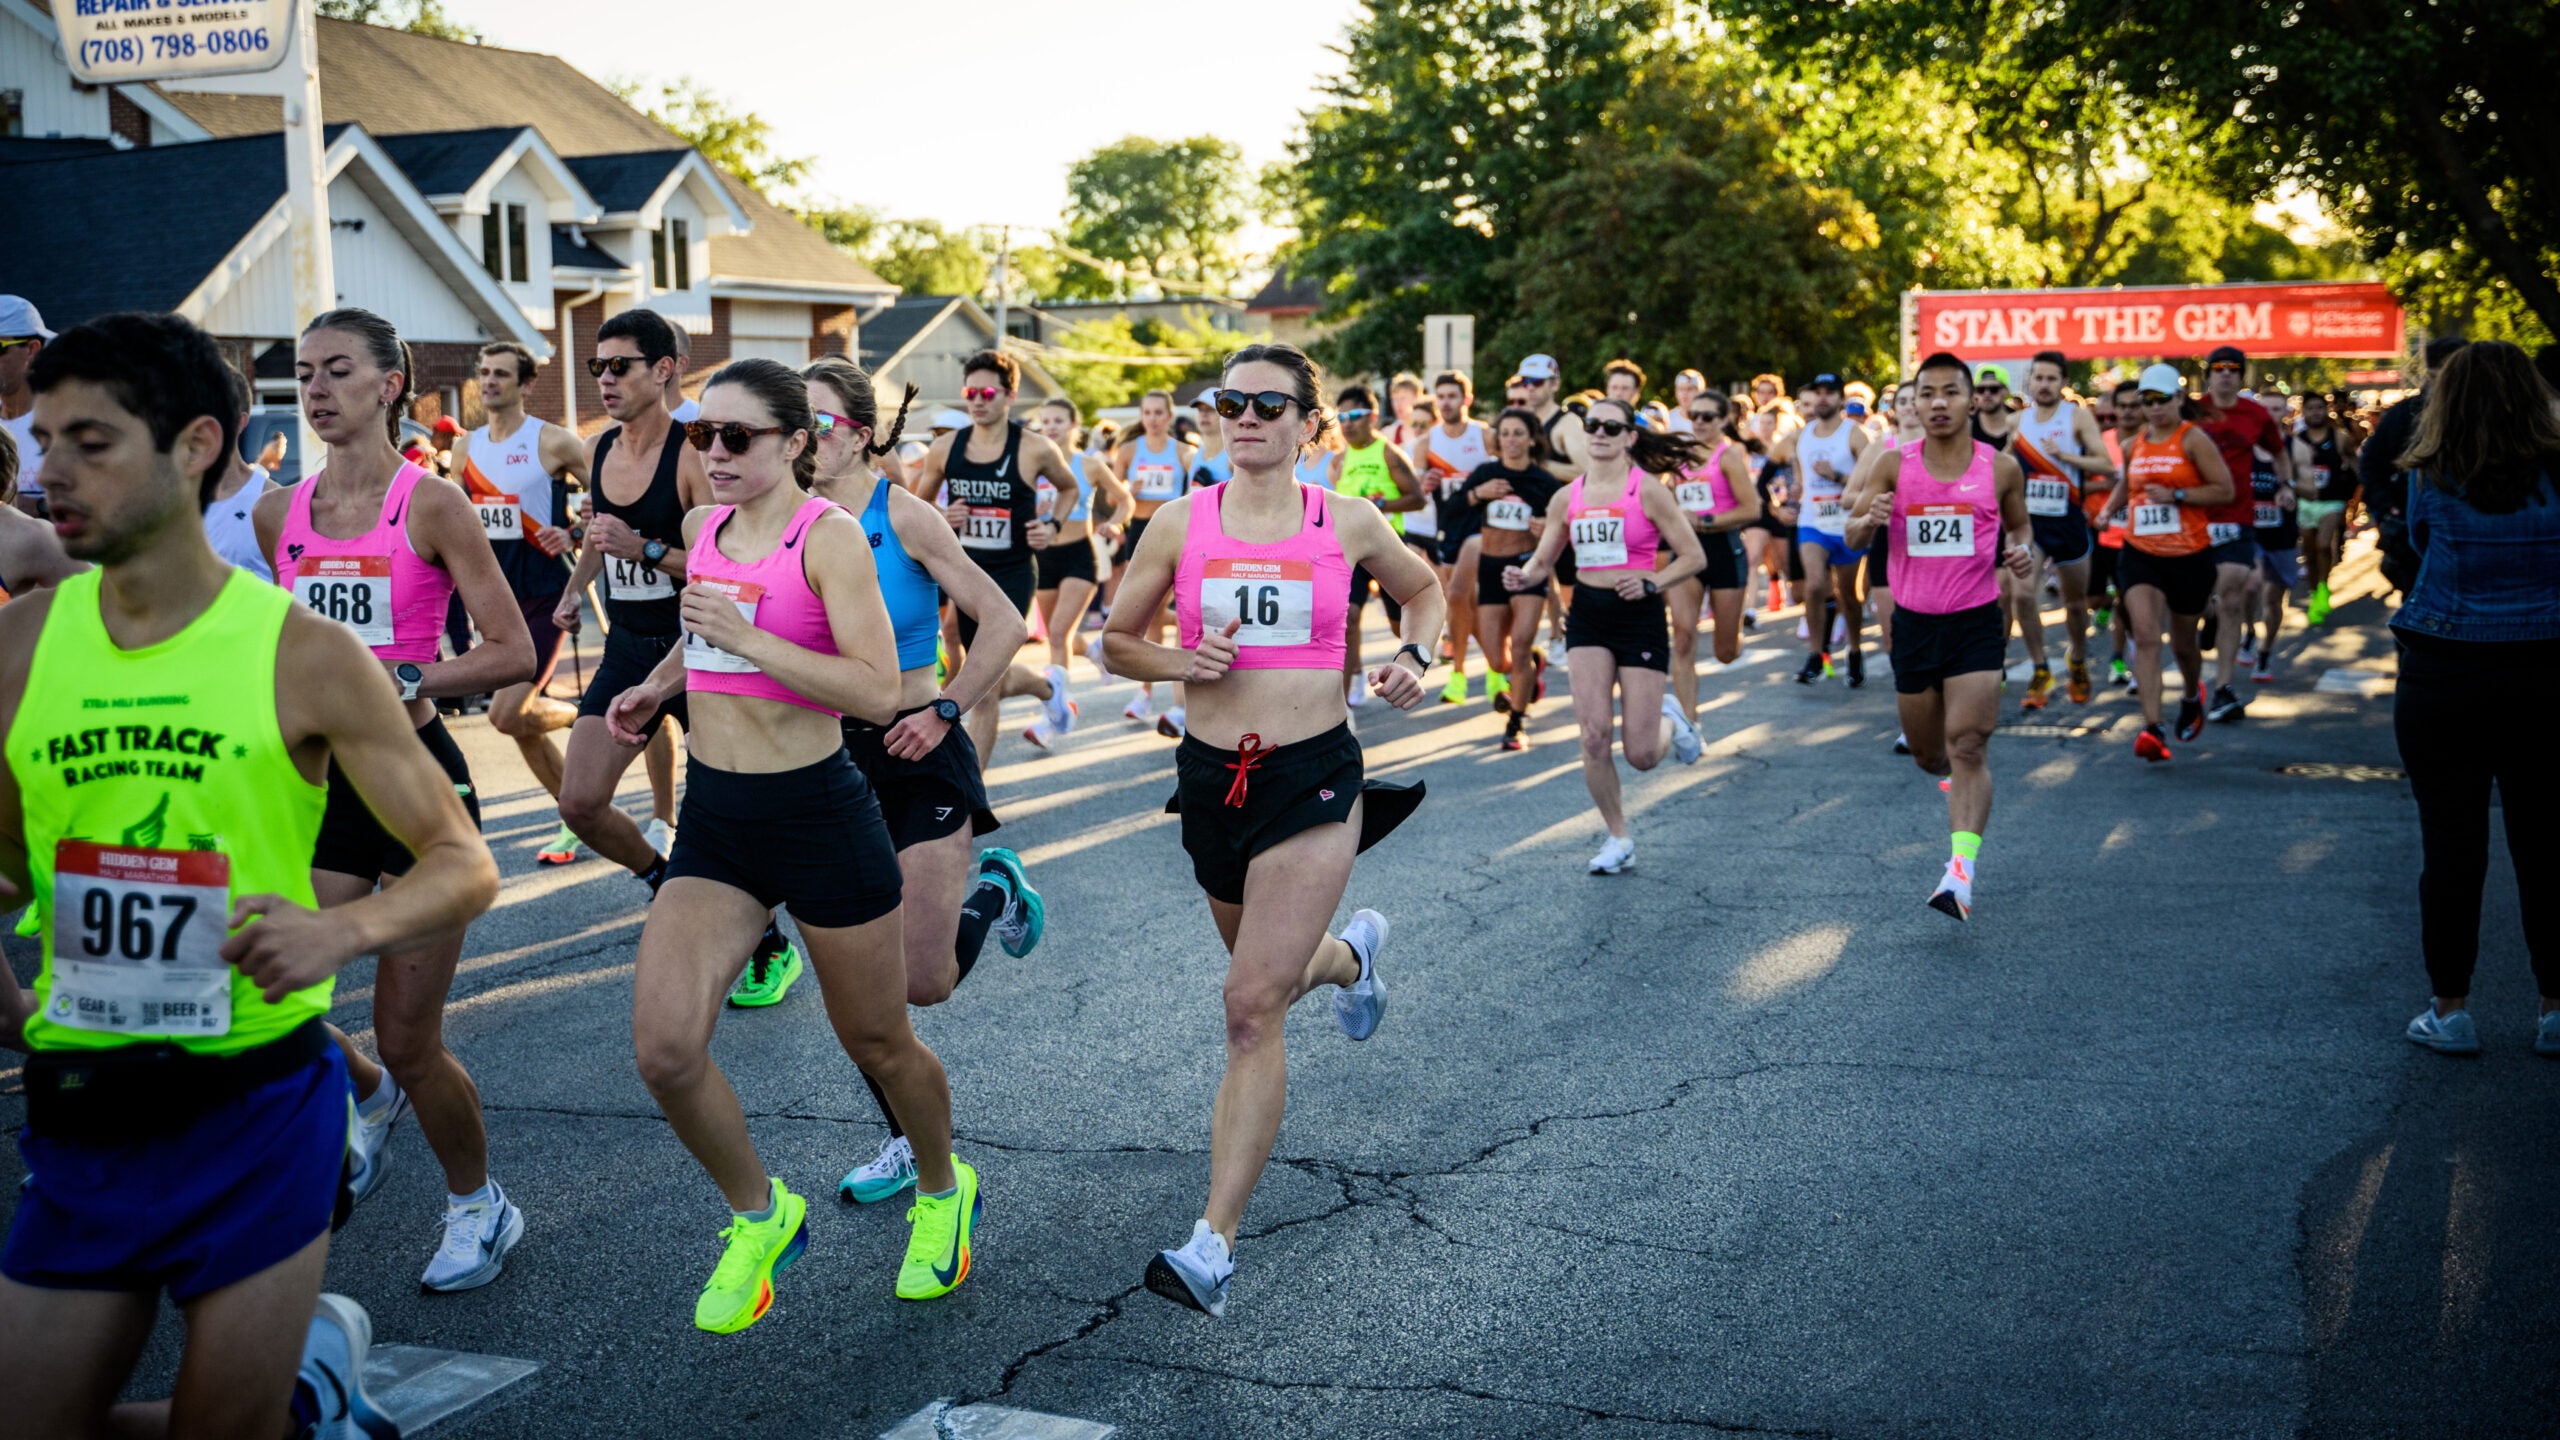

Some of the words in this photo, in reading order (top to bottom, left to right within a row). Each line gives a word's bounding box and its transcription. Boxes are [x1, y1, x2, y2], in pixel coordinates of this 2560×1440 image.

[96, 20, 117, 31] ALL
[124, 16, 171, 28] MAKES
[191, 11, 248, 22] MODELS
[80, 35, 144, 69] (708)
[152, 28, 269, 59] 798-0806
[1935, 308, 2066, 347] START
[2073, 305, 2166, 344] THE
[2173, 301, 2273, 342] GEM
[951, 478, 1011, 499] 3RUN2
[481, 508, 513, 528] 948
[965, 518, 1006, 538] 1117
[1577, 521, 1619, 544] 1197
[1919, 519, 1962, 544] 824
[616, 560, 657, 586] 478
[309, 582, 372, 625] 868
[1235, 585, 1280, 626] 16
[49, 727, 109, 765] FAST
[116, 725, 226, 759] TRACK
[63, 760, 140, 788] RACING
[145, 760, 204, 783] TEAM
[100, 851, 147, 869] HIDDEN
[149, 856, 178, 871] GEM
[100, 868, 121, 879] HALF
[123, 871, 178, 884] MARATHON
[82, 887, 198, 961] 967
[79, 997, 105, 1013] GEAR
[163, 1002, 197, 1016] BEER
